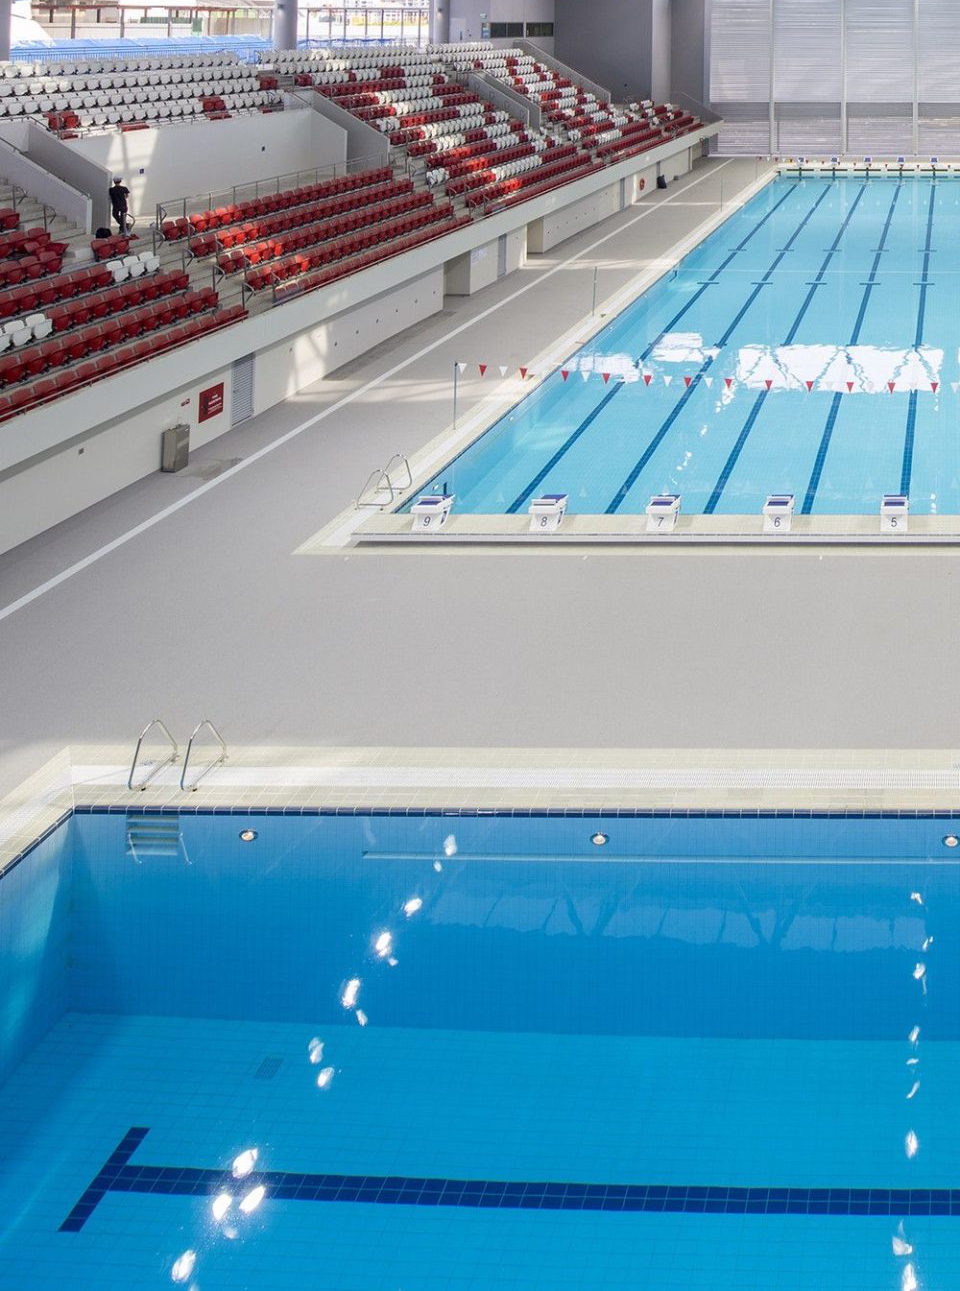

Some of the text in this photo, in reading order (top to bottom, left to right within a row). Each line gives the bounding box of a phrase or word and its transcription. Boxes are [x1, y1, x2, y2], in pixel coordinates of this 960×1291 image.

[423, 516, 431, 527] 9
[541, 517, 548, 527] 8
[657, 517, 664, 527] 7
[774, 517, 781, 528] 6
[891, 517, 898, 528] 5
